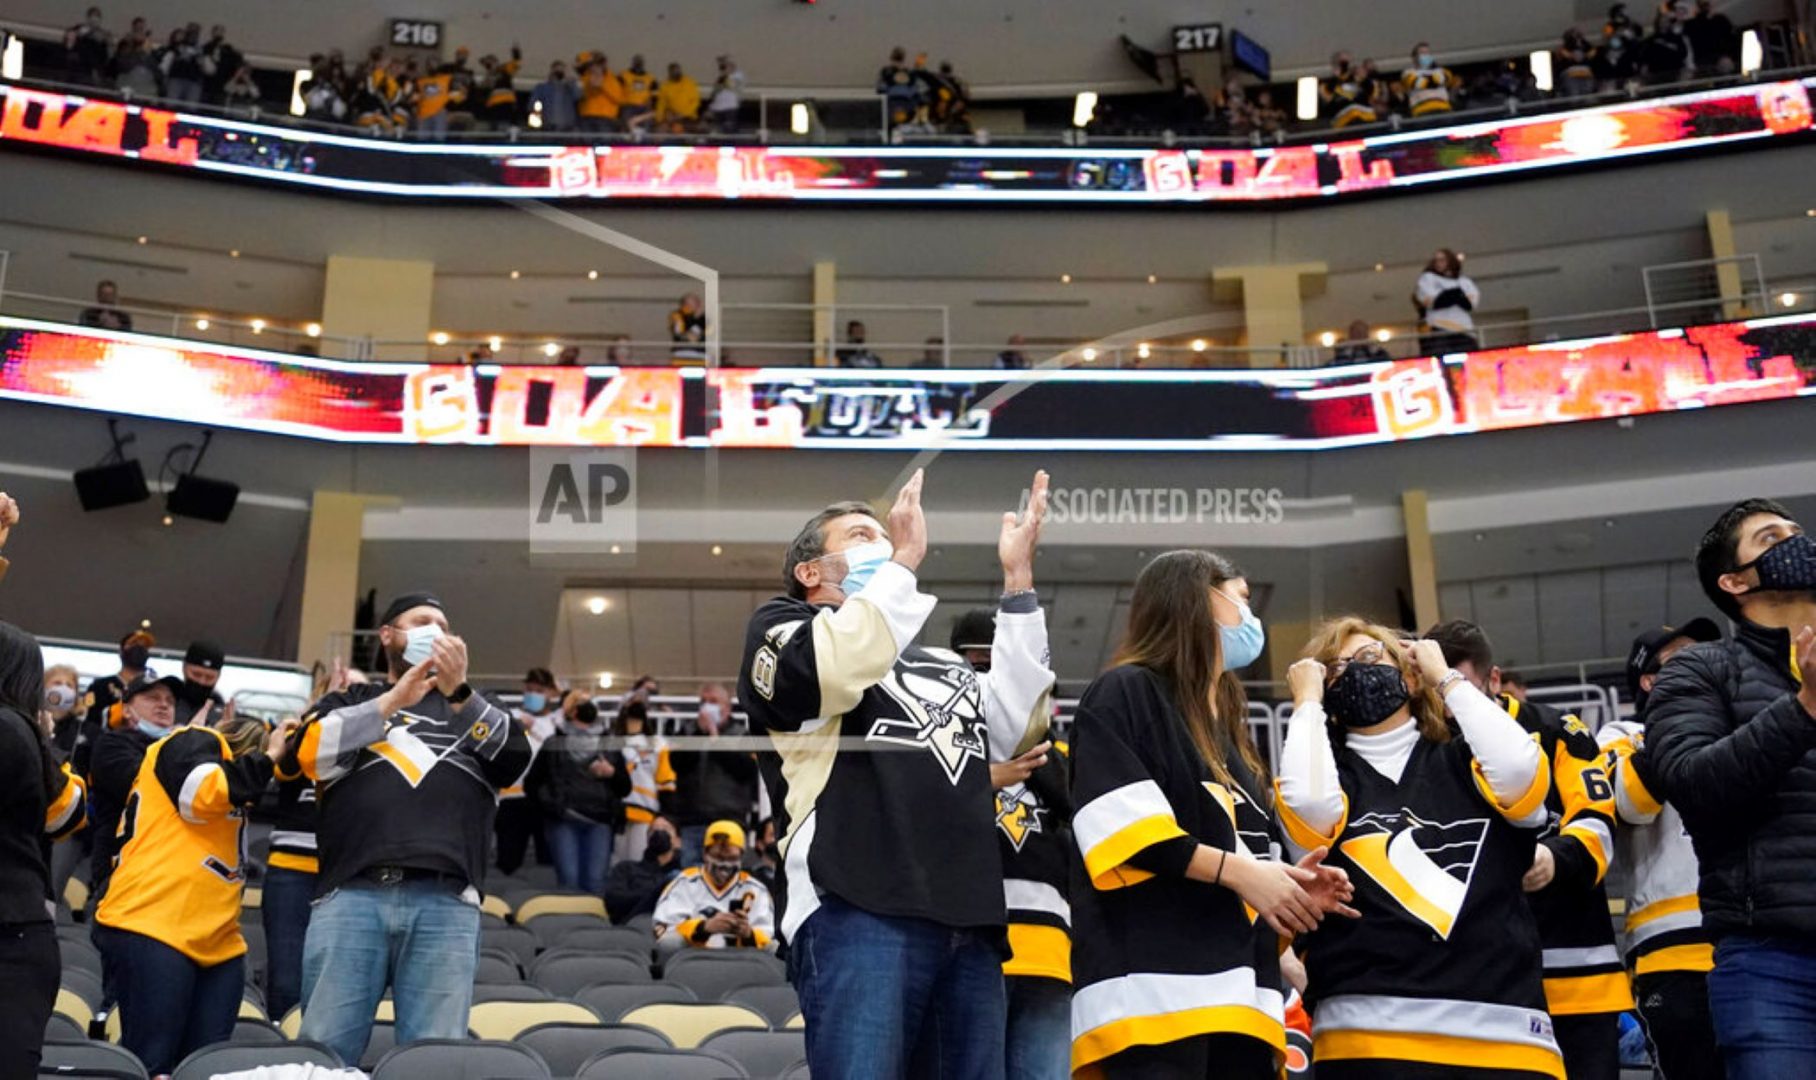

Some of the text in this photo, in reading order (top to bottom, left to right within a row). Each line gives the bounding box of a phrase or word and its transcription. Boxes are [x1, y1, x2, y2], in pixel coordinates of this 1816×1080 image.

[394, 22, 438, 46] 216
[1176, 27, 1220, 50] 217
[395, 365, 803, 447] GOAL
